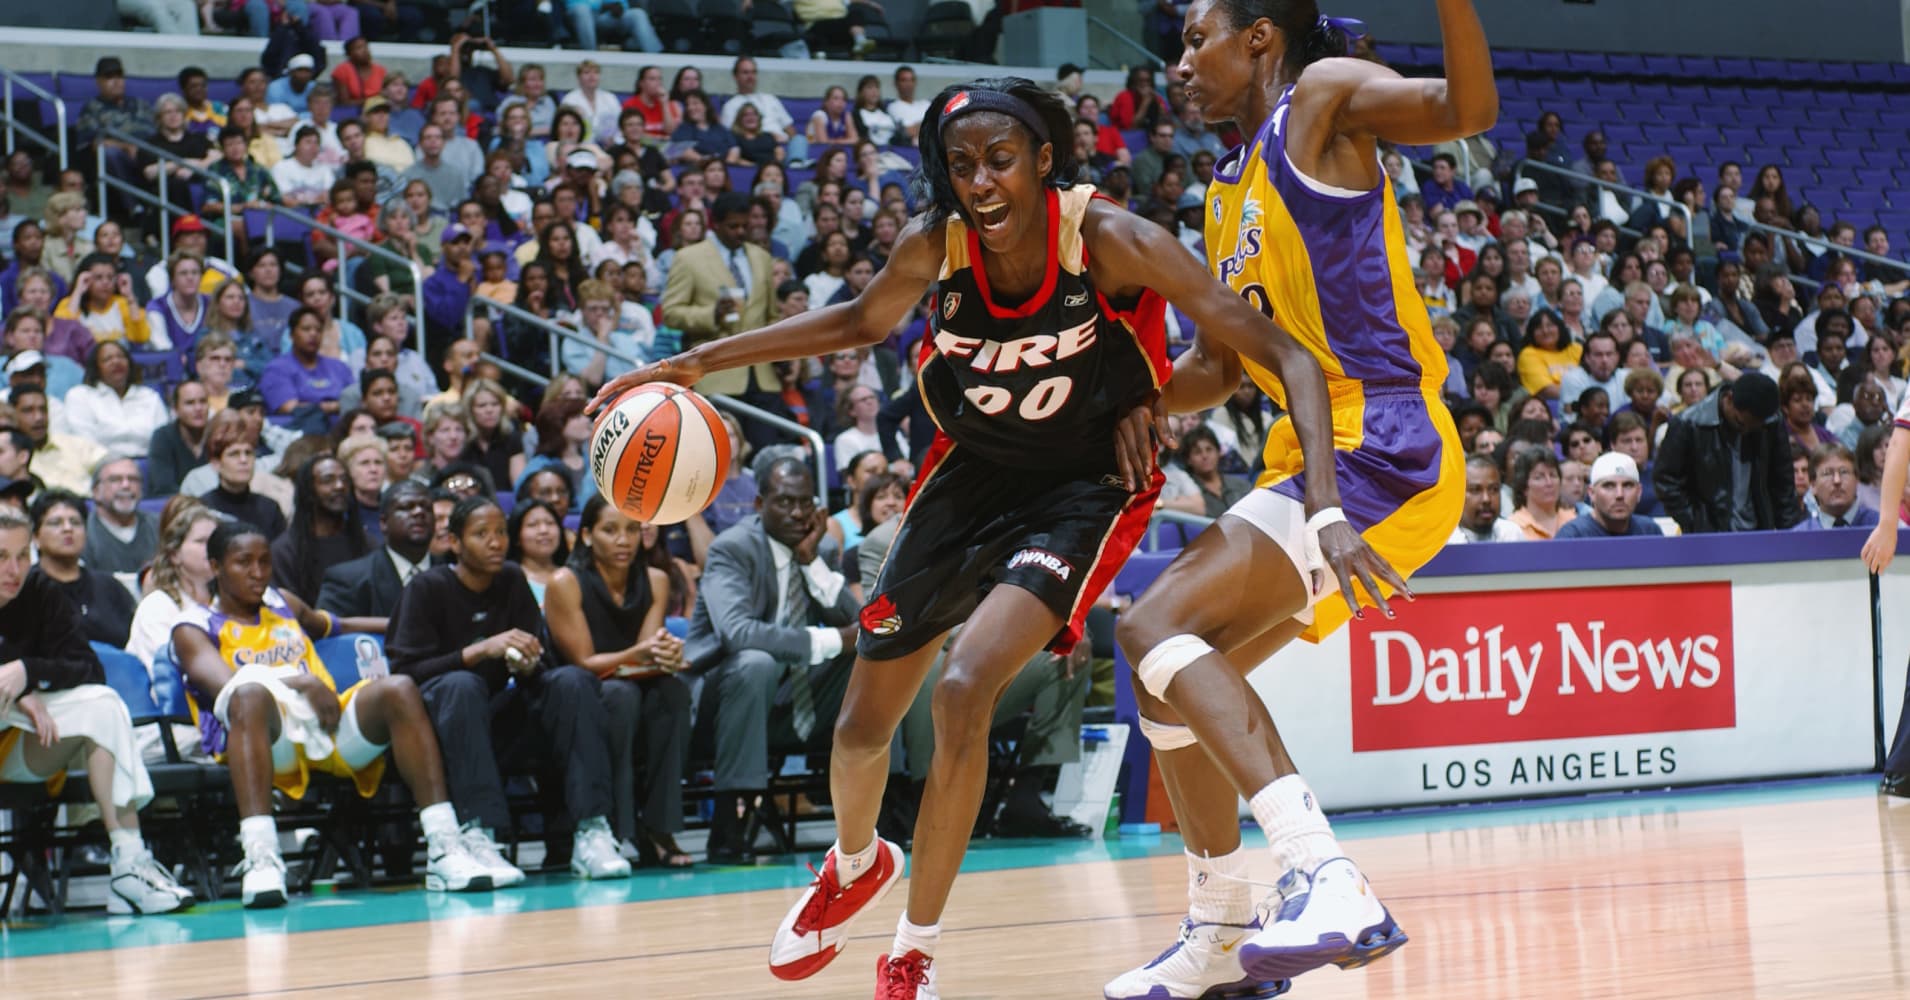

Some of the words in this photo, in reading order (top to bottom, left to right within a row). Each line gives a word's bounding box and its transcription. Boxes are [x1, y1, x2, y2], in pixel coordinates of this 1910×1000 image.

[934, 313, 1098, 373] FIRE
[964, 376, 1073, 421] 00
[1020, 550, 1070, 580] WNBA
[1370, 624, 1543, 715] Daily
[1556, 620, 1721, 695] News
[1423, 759, 1492, 790] LOS
[1510, 747, 1676, 784] ANGELES
